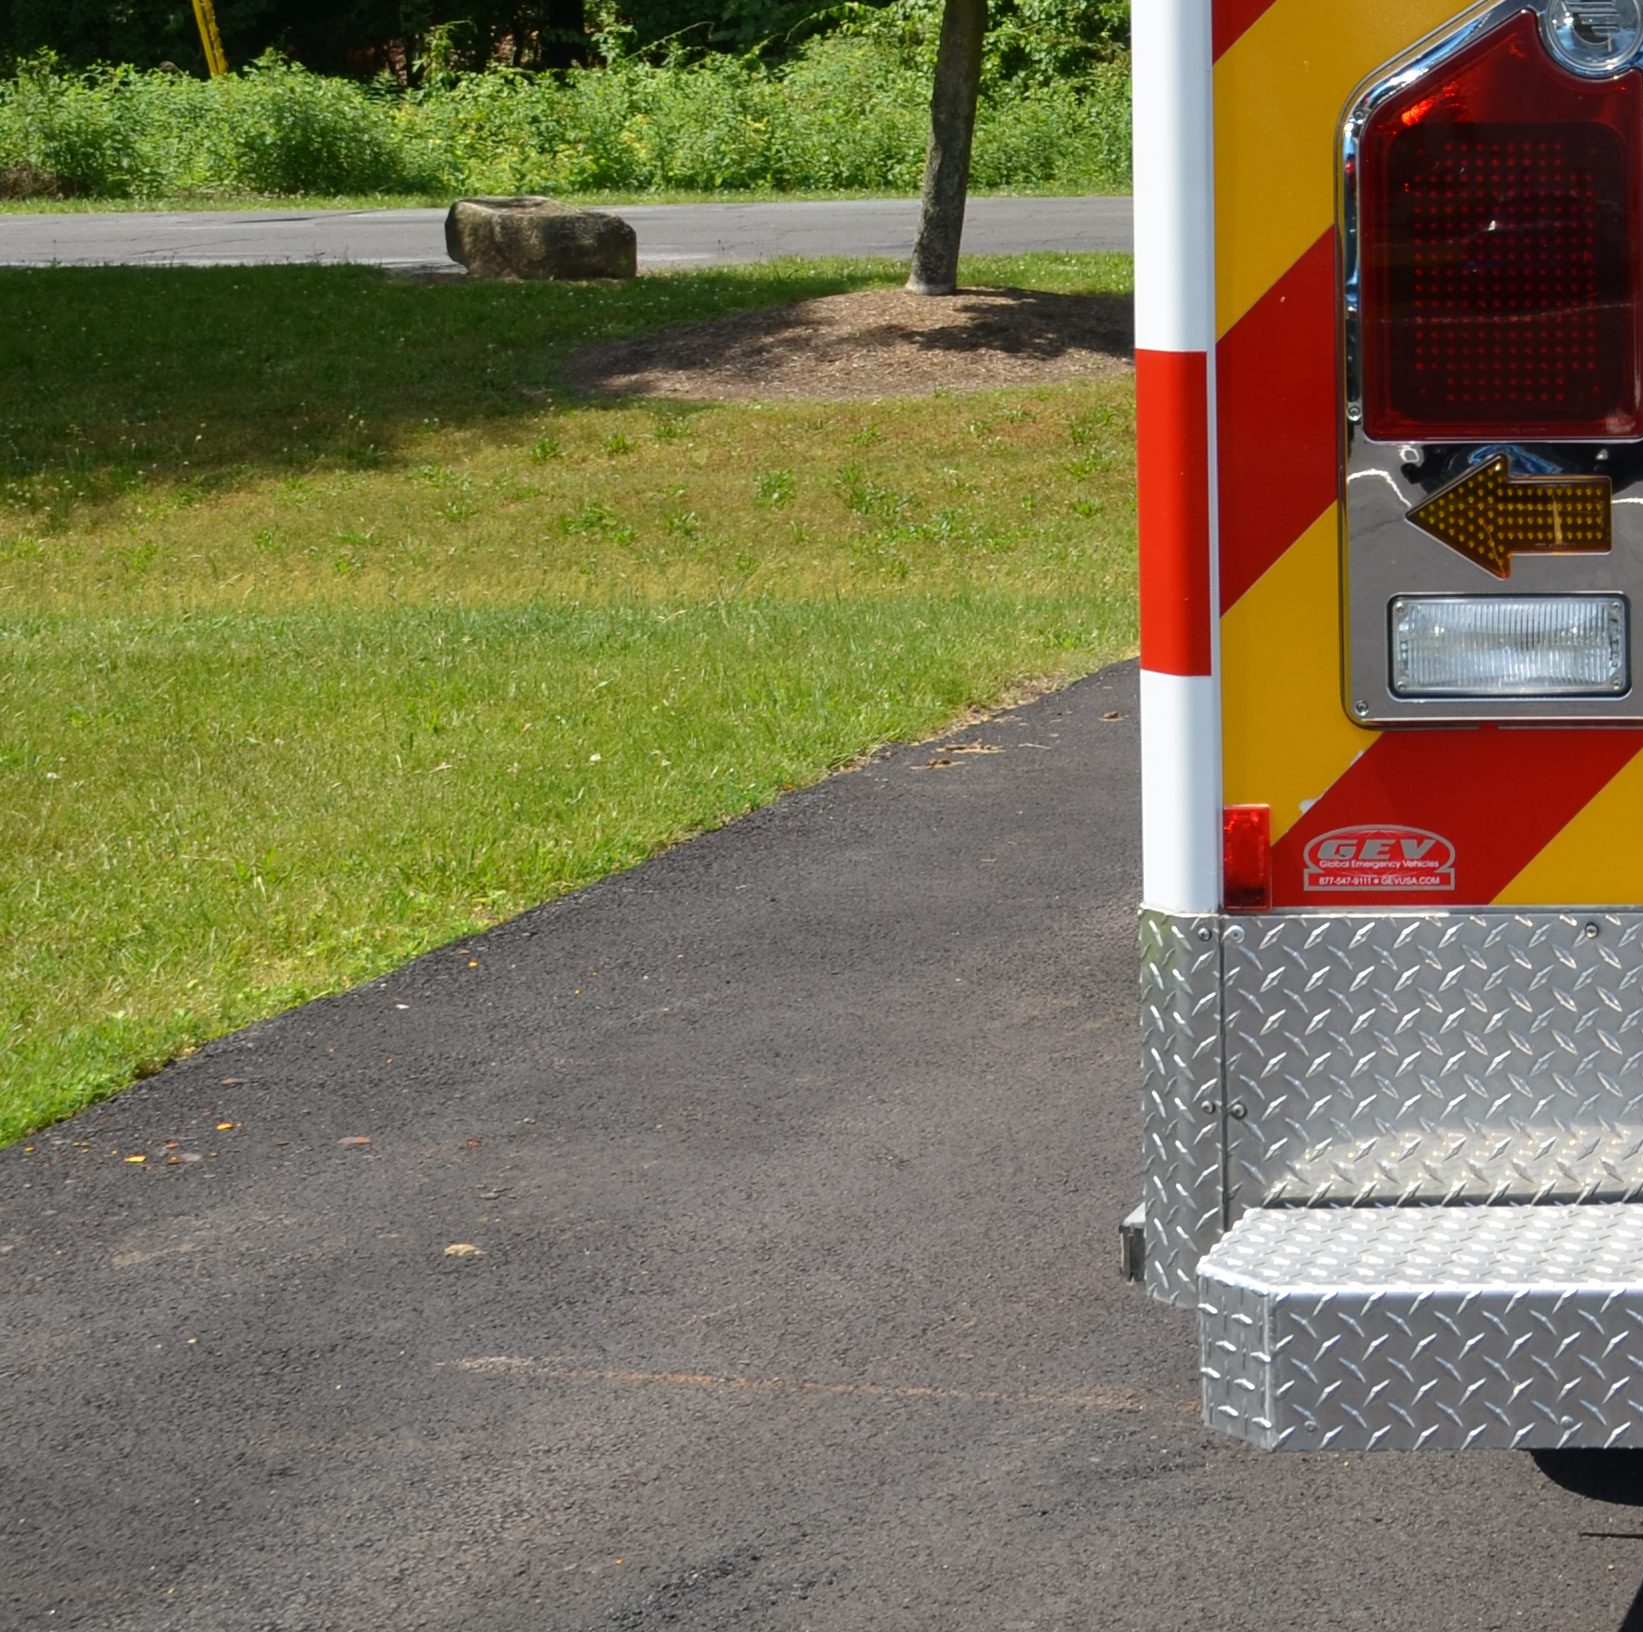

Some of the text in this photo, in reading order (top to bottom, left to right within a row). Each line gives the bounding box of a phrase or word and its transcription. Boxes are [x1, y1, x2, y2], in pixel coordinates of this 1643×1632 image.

[1317, 839, 1437, 860] GEV
[1319, 860, 1439, 869] Global Emergency Vehicles
[1380, 876, 1440, 885] GEVUSA.COM
